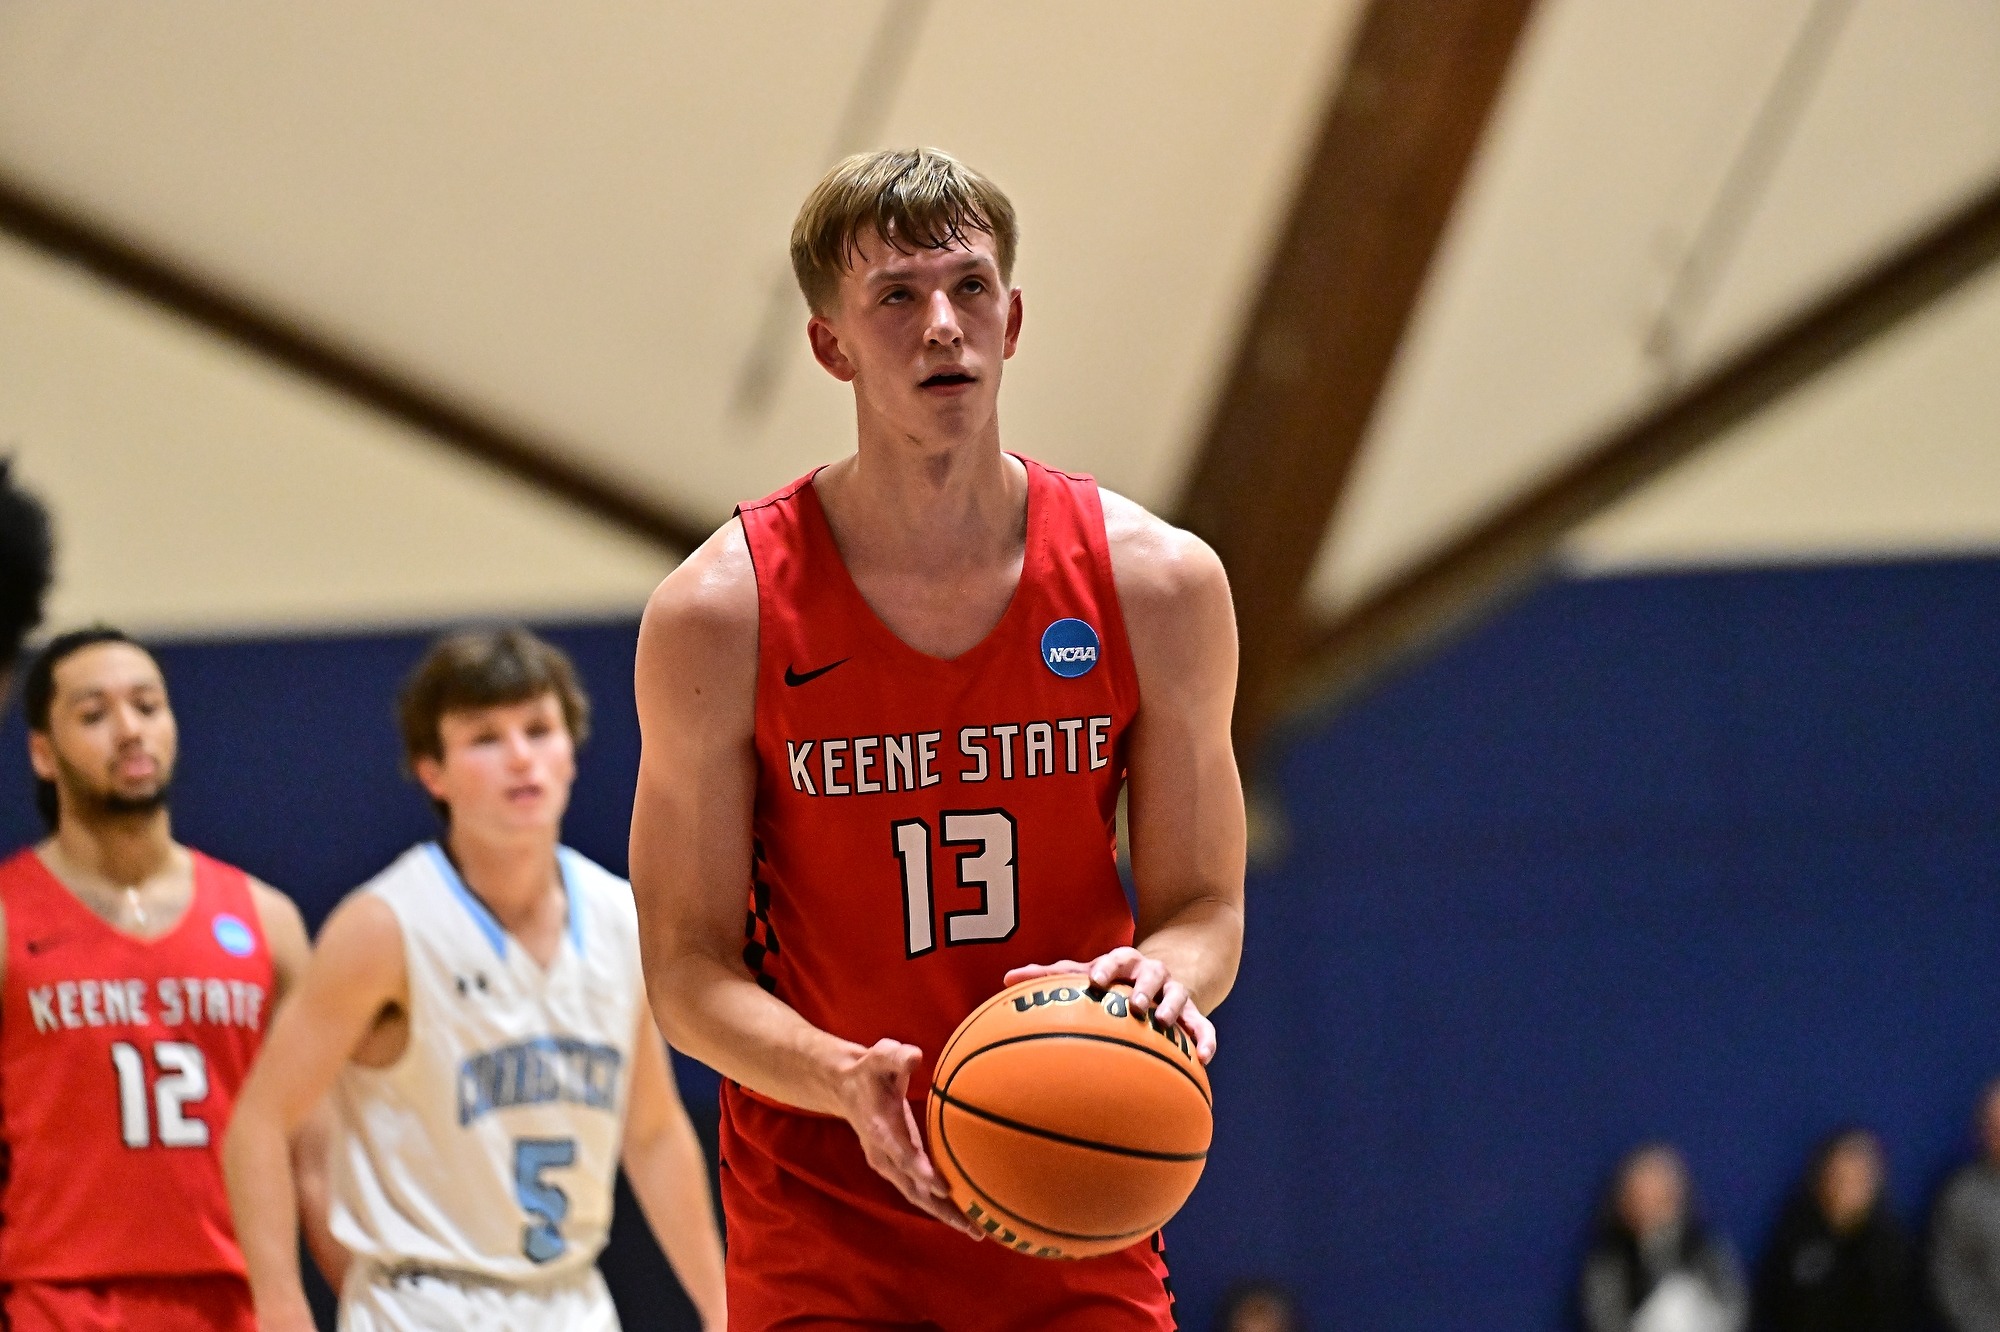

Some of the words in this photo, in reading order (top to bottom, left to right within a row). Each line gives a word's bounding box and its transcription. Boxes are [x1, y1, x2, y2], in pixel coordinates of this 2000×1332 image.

[1049, 646, 1096, 663] NCAA
[786, 730, 943, 797] KEENE
[955, 714, 1113, 784] STATE
[890, 806, 1020, 960] 13
[27, 980, 151, 1034] KEENE
[156, 976, 265, 1032] STATE
[110, 1039, 210, 1150] 12
[513, 1136, 577, 1264] 5
